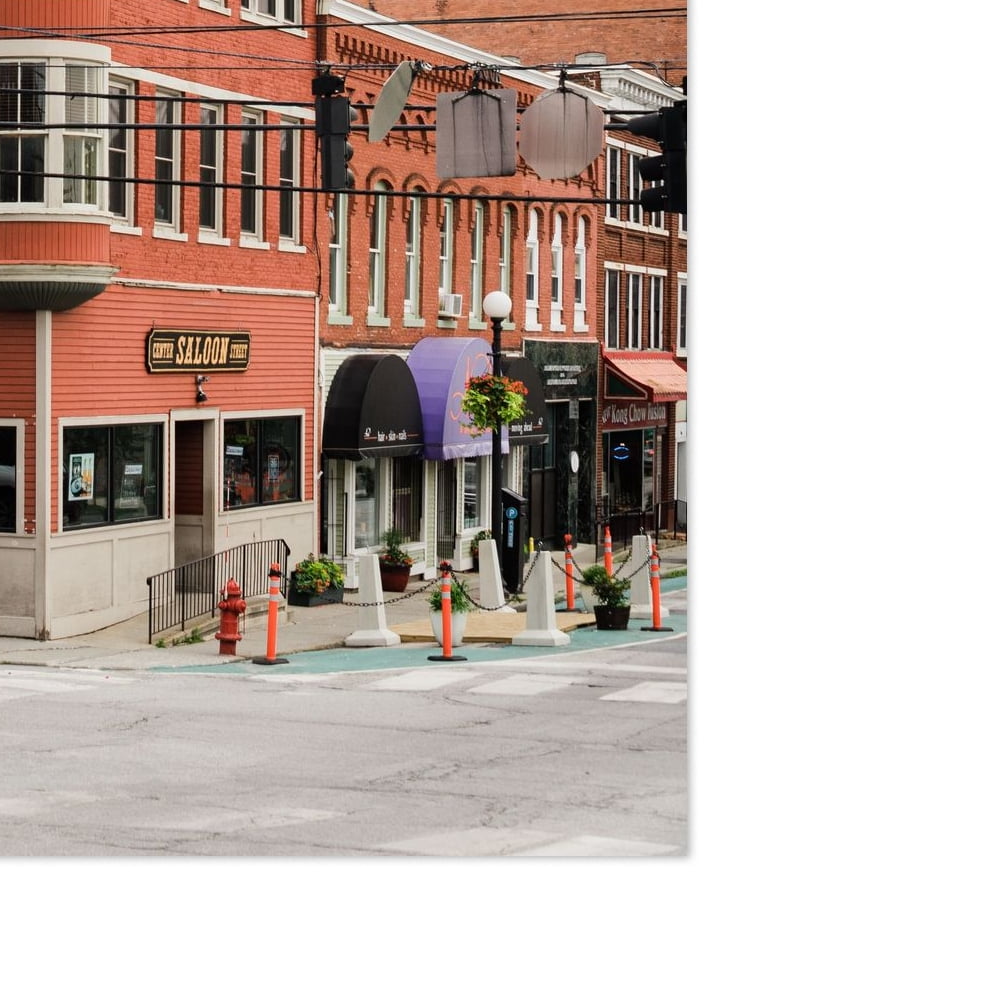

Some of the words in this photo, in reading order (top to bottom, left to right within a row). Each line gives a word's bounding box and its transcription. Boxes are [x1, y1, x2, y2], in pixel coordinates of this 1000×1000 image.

[152, 343, 174, 359] CENTER
[175, 335, 230, 365] SALOON
[229, 344, 248, 359] STREET
[611, 403, 628, 425] Kong
[628, 403, 647, 422] Chow
